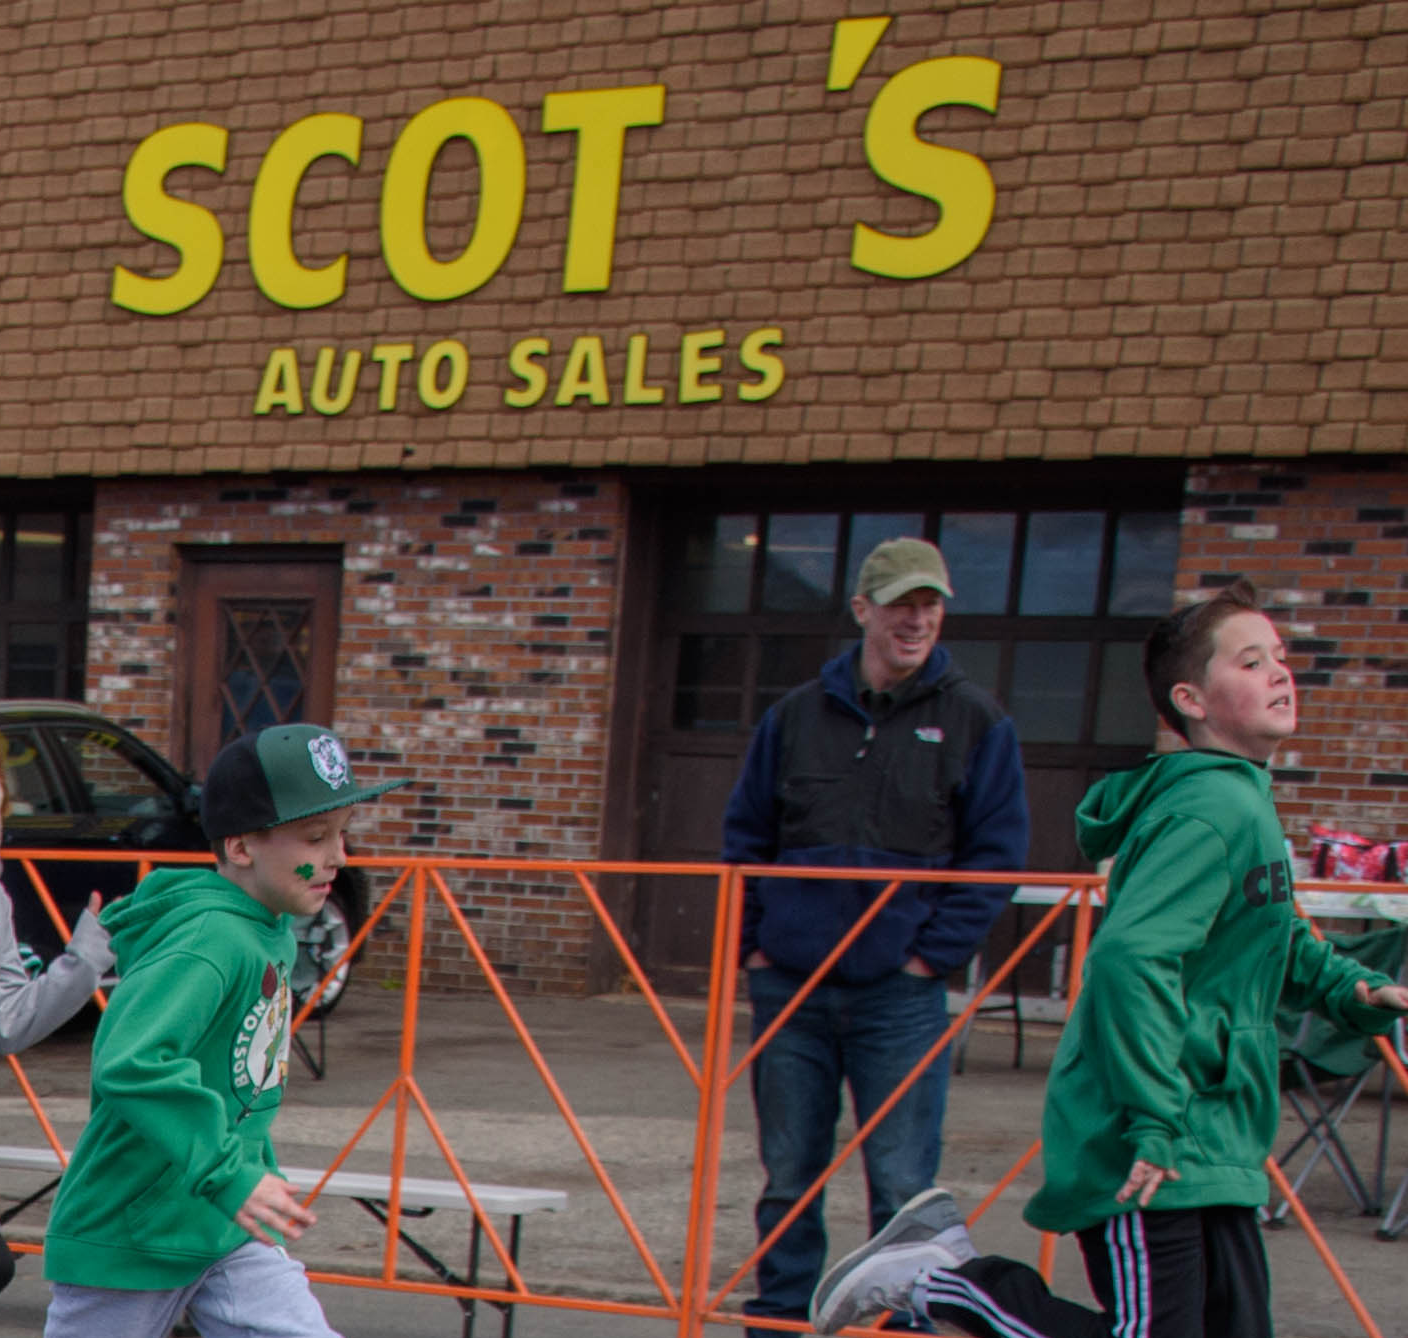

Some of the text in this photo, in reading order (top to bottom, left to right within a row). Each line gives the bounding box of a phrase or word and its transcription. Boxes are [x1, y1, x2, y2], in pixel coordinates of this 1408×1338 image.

[253, 327, 786, 416] AUTO SALES
[233, 999, 268, 1089] BOSTON
